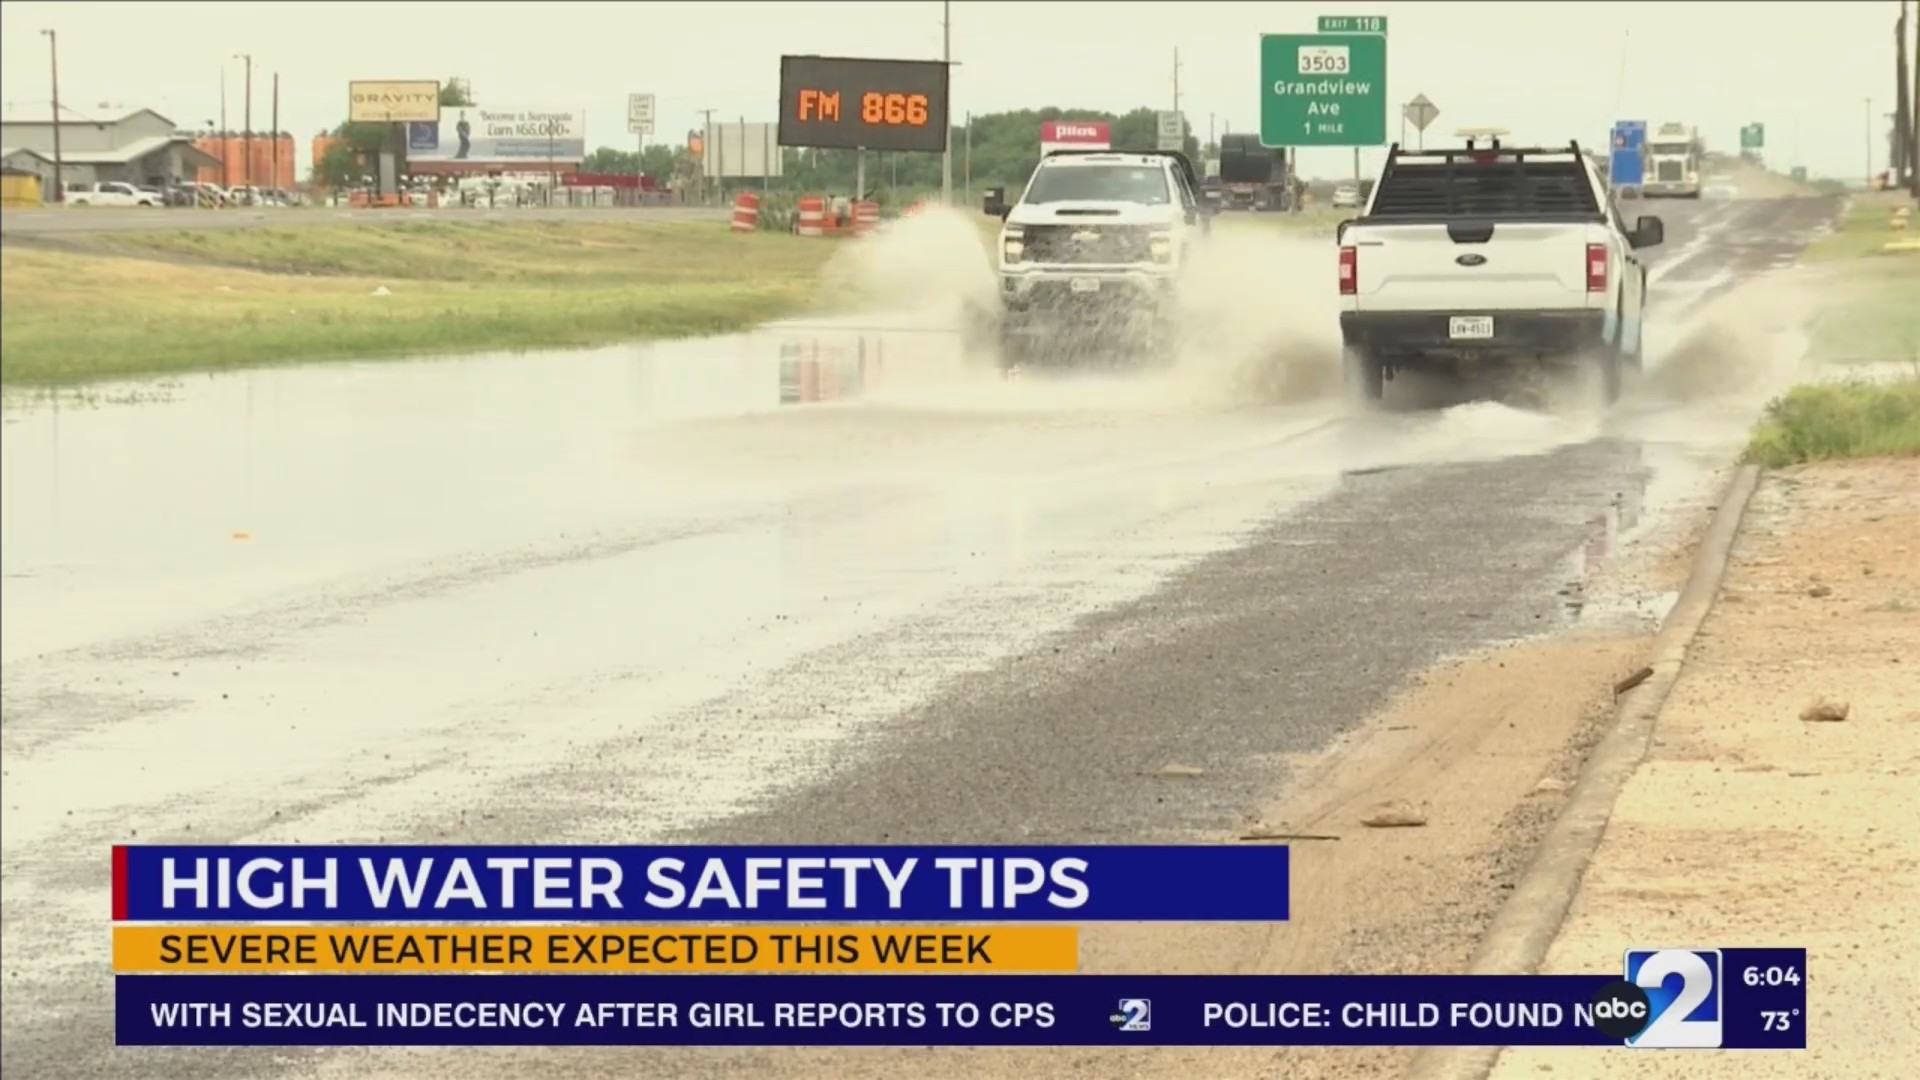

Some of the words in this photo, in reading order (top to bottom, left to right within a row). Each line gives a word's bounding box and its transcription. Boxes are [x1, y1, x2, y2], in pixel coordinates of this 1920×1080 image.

[1324, 18, 1347, 30] EXIT
[1356, 18, 1380, 31] 118
[1301, 55, 1347, 71] 3503
[1274, 79, 1370, 95] Grandview
[353, 93, 435, 104] GRAVITY
[799, 89, 840, 121] FM
[861, 91, 928, 125] 866
[1307, 101, 1340, 116] Ave
[480, 110, 515, 122] Become
[518, 112, 526, 122] a
[487, 122, 513, 137] Earn
[1304, 121, 1311, 135] 1
[1318, 123, 1344, 133] MILE
